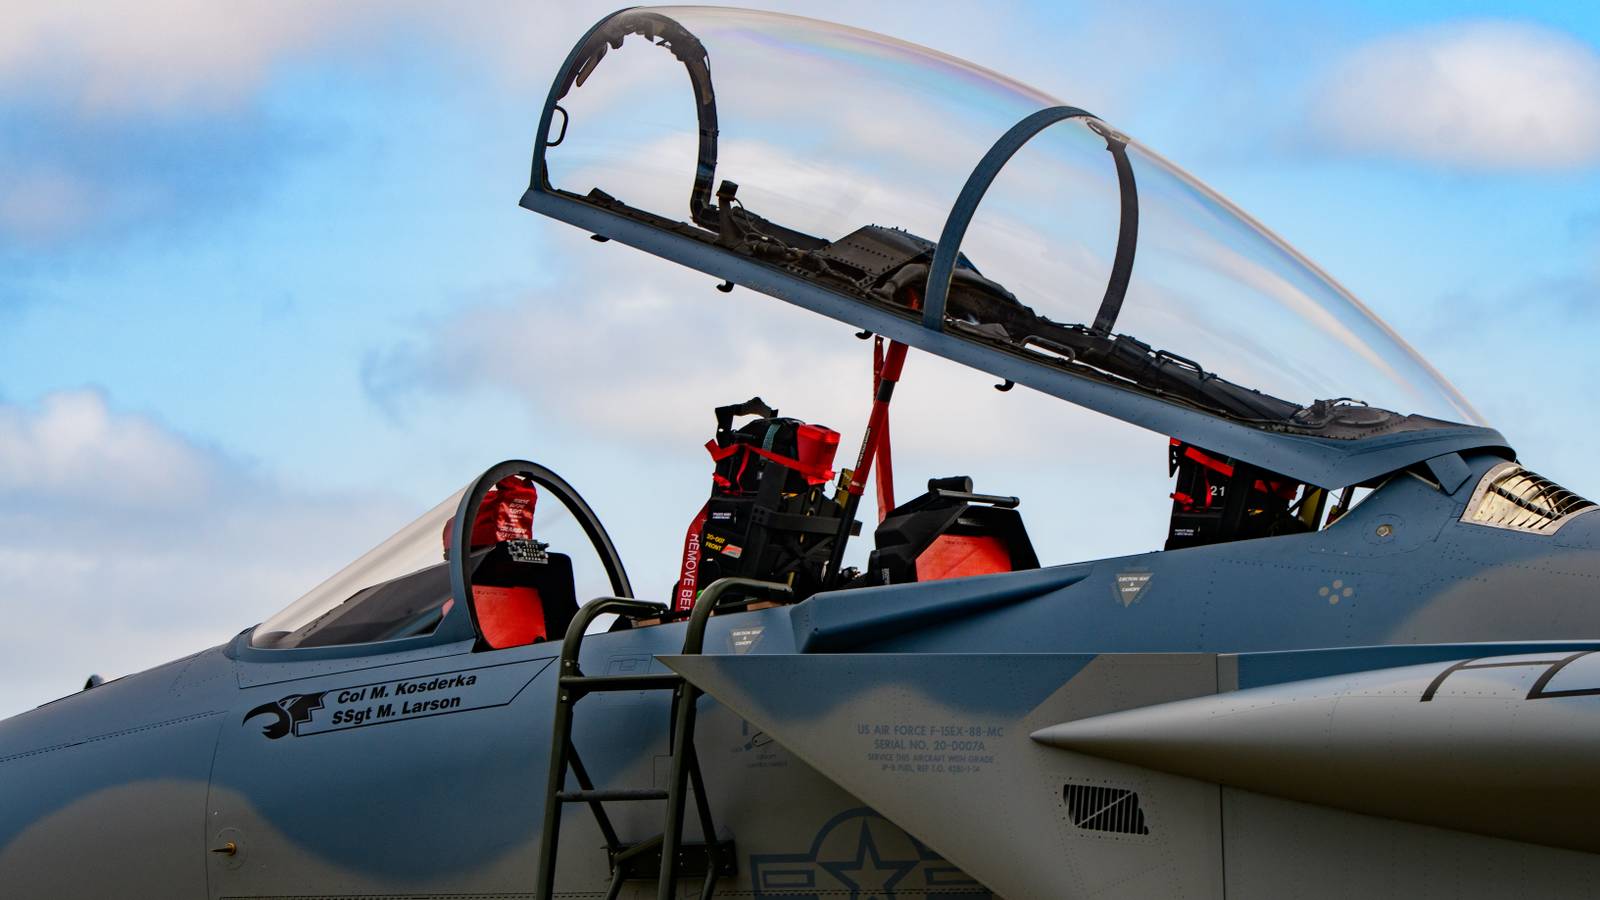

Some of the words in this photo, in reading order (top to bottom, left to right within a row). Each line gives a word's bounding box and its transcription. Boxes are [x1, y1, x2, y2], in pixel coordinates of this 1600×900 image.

[1211, 486, 1225, 496] 21
[705, 541, 722, 551] FRONT
[337, 688, 367, 704] Col
[370, 685, 389, 700] M.
[395, 674, 477, 696] Kosderka
[332, 707, 372, 725] SSgt
[376, 703, 396, 718] M.
[402, 696, 461, 715] Larson
[857, 724, 870, 735] US
[874, 725, 890, 736] AIR
[894, 725, 927, 736] FORCE
[873, 739, 905, 750] SERIAL
[909, 740, 929, 751] NO.
